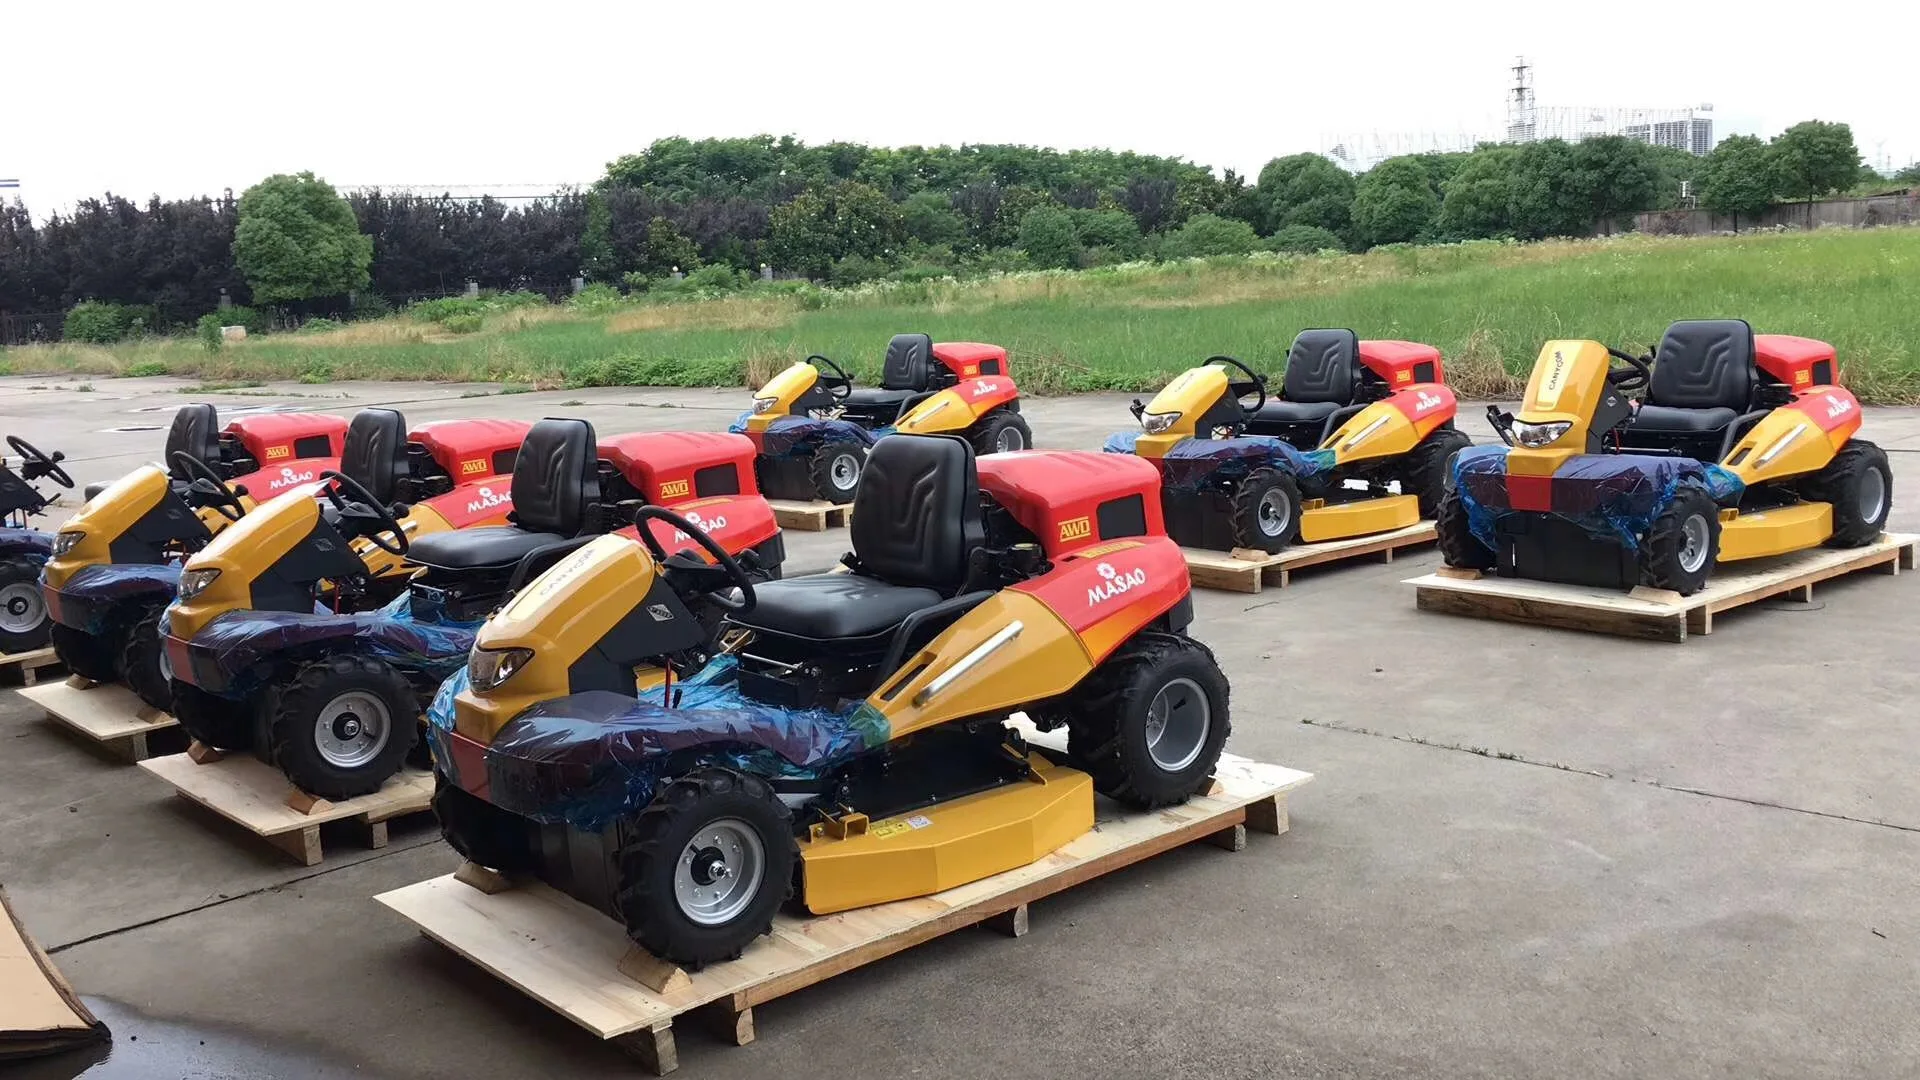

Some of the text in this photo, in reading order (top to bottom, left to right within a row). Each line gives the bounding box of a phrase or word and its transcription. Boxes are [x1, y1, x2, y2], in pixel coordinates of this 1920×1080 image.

[1548, 350, 1564, 390] CANYCOM
[266, 447, 289, 457] AWD
[462, 461, 488, 472] AWD
[270, 471, 313, 489] MASAO
[660, 481, 689, 496] AWD
[674, 516, 727, 543] MSAO
[1060, 519, 1091, 540] AWD
[1088, 567, 1146, 607] MASAO
